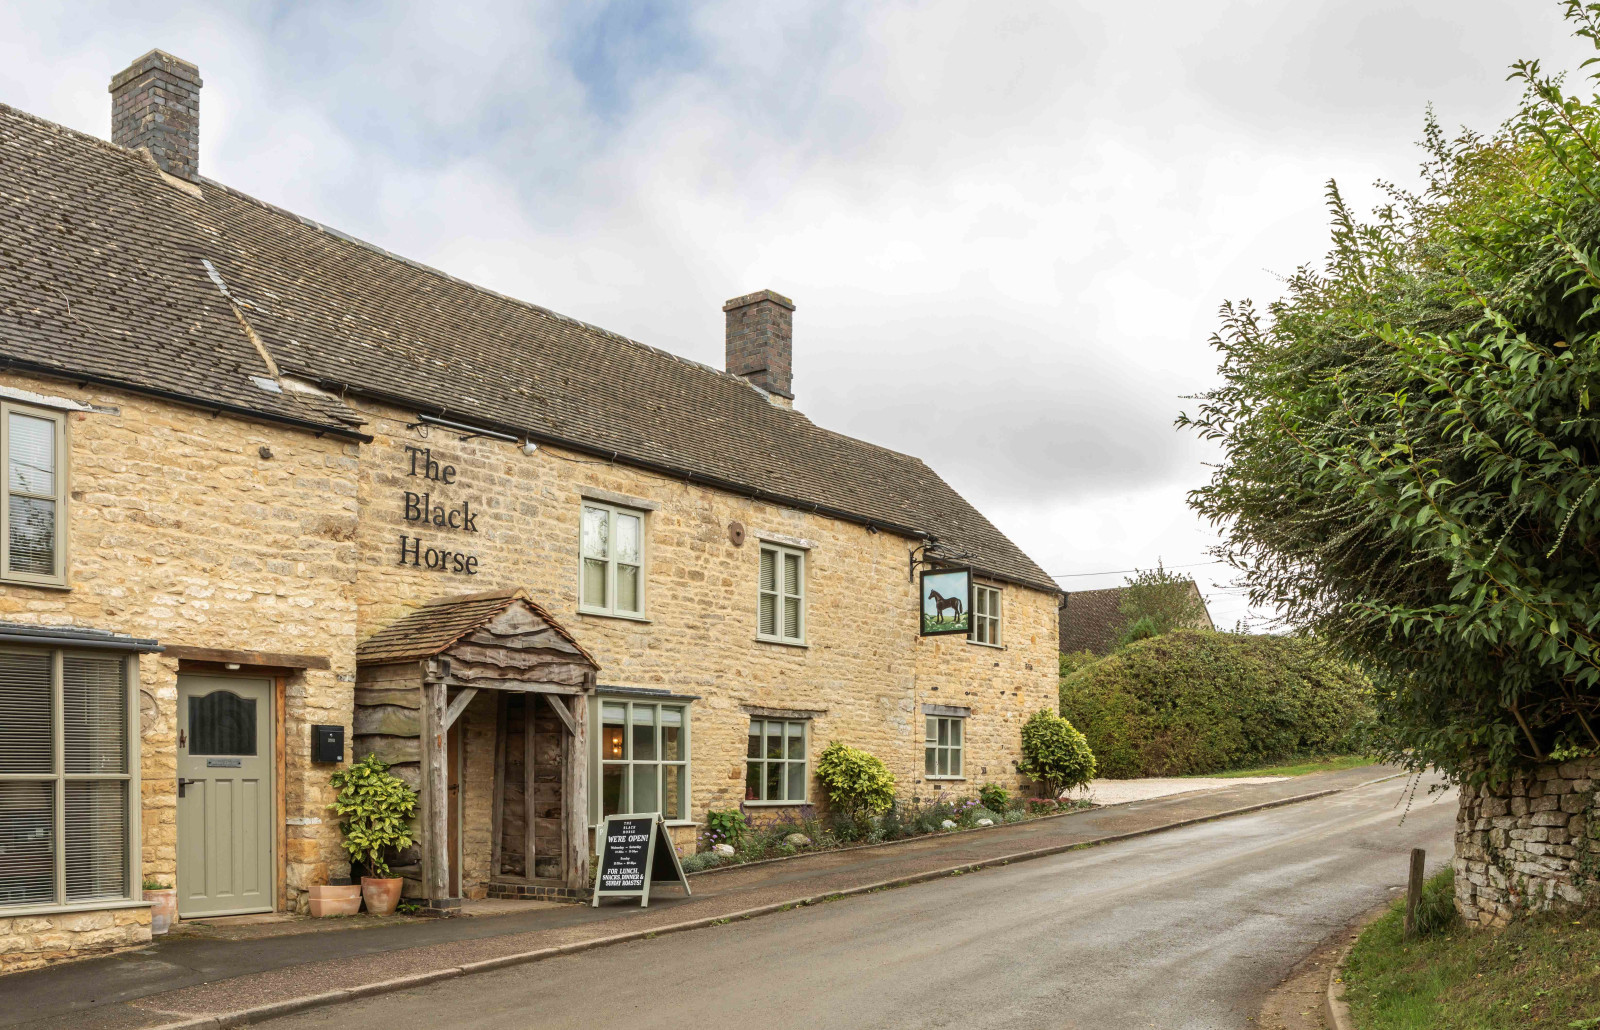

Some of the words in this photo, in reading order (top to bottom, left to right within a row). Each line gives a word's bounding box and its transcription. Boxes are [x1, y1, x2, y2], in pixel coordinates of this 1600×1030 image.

[405, 445, 456, 485] The
[404, 491, 478, 532] Black
[400, 535, 478, 575] Horse
